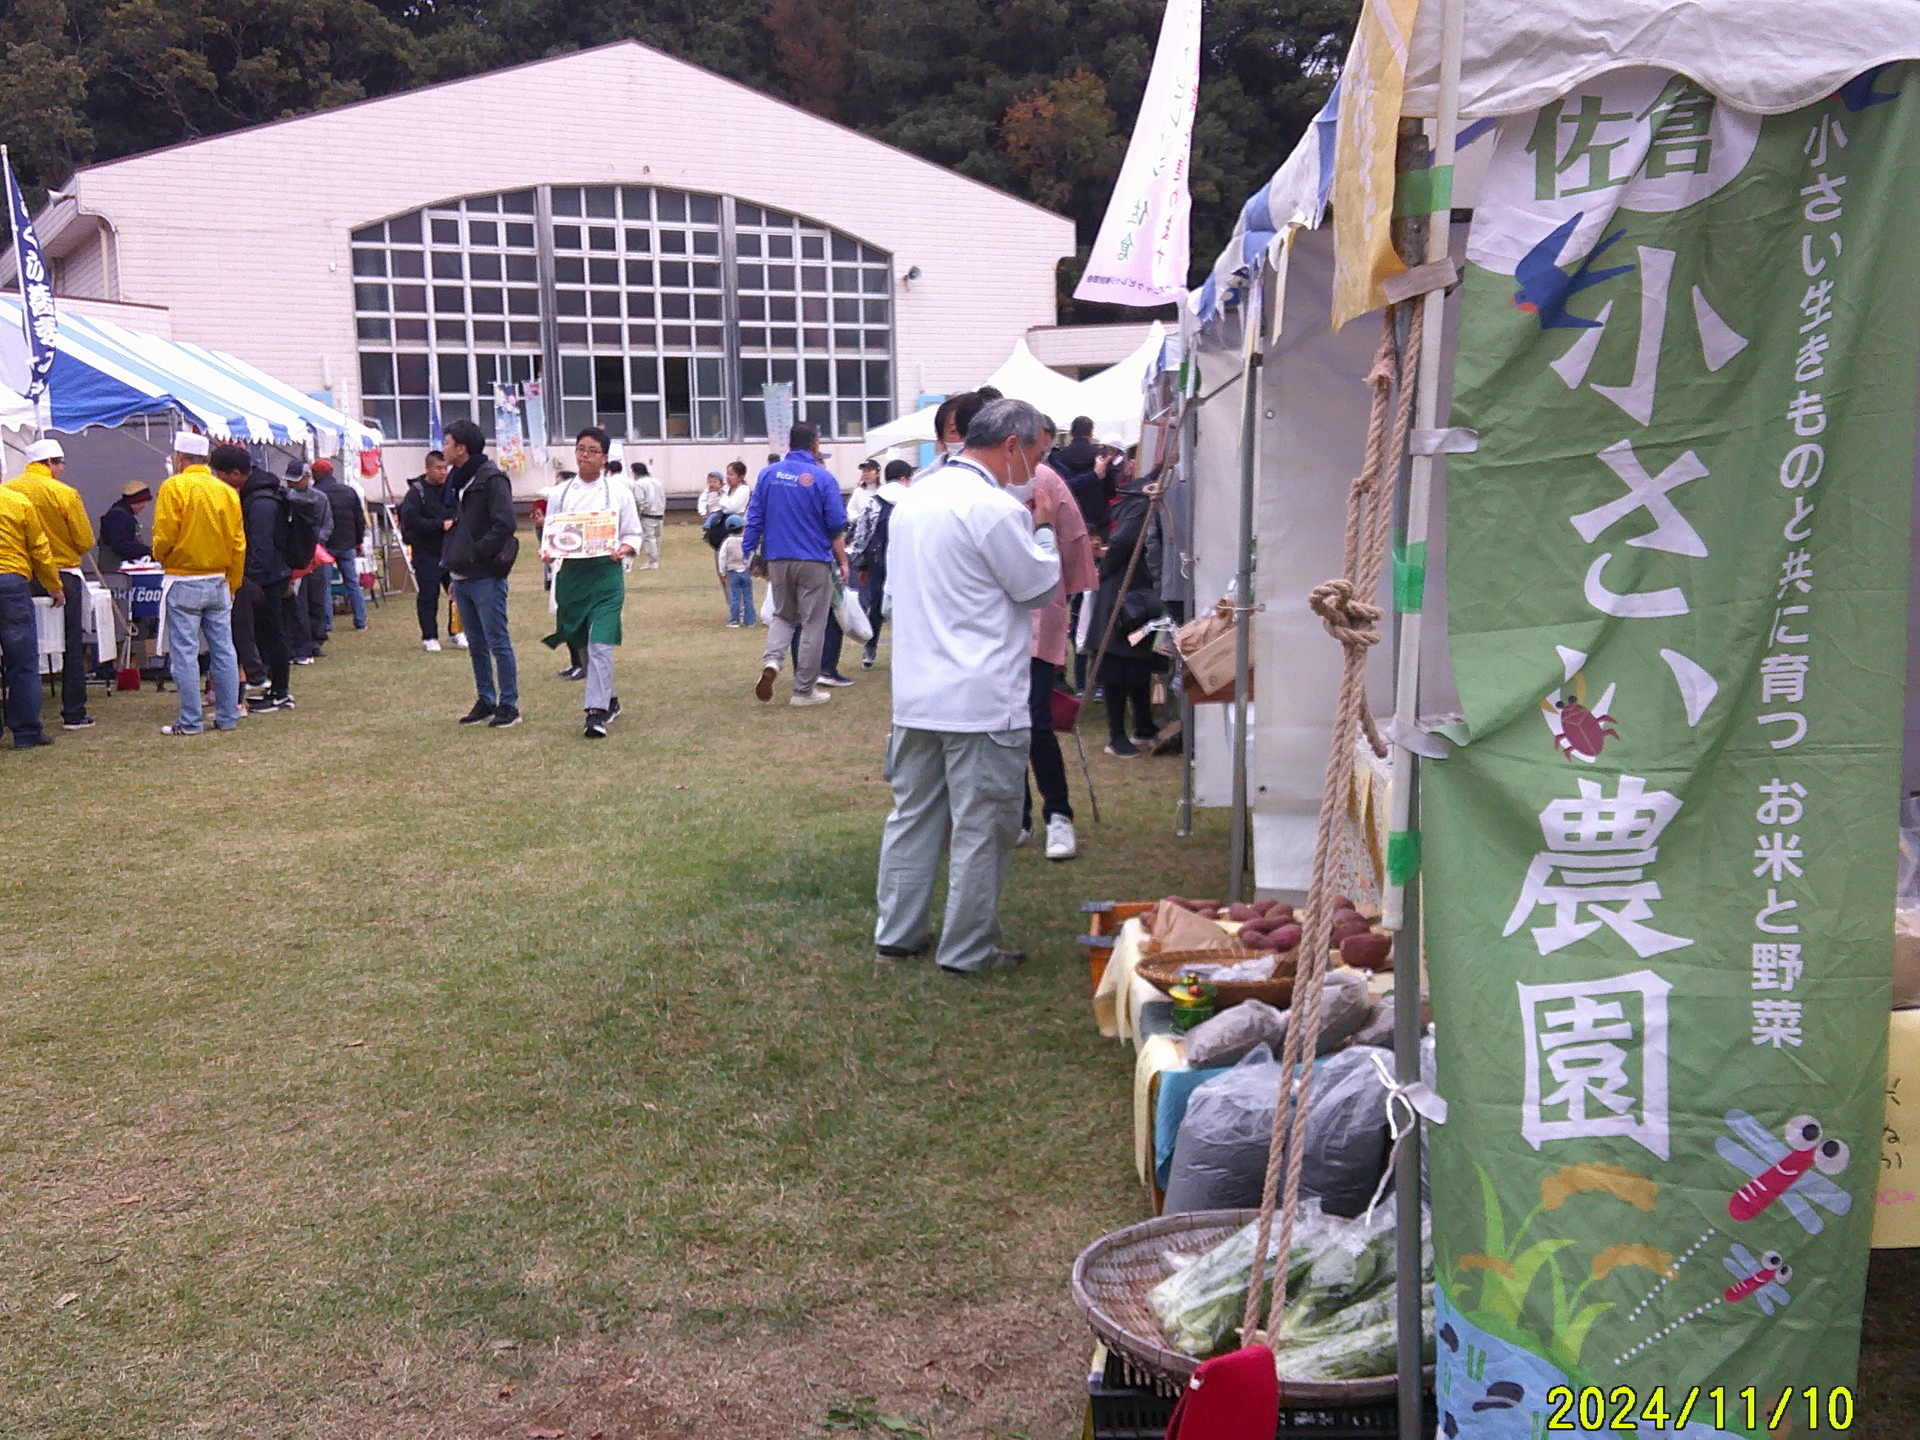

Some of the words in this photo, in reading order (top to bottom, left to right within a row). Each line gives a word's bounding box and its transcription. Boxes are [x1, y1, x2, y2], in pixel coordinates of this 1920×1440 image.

[1503, 245, 1748, 1161] 小さい農園
[1757, 113, 1848, 750] 小さい生きものと共に育つ
[1751, 778, 1808, 1048] お米と野菜
